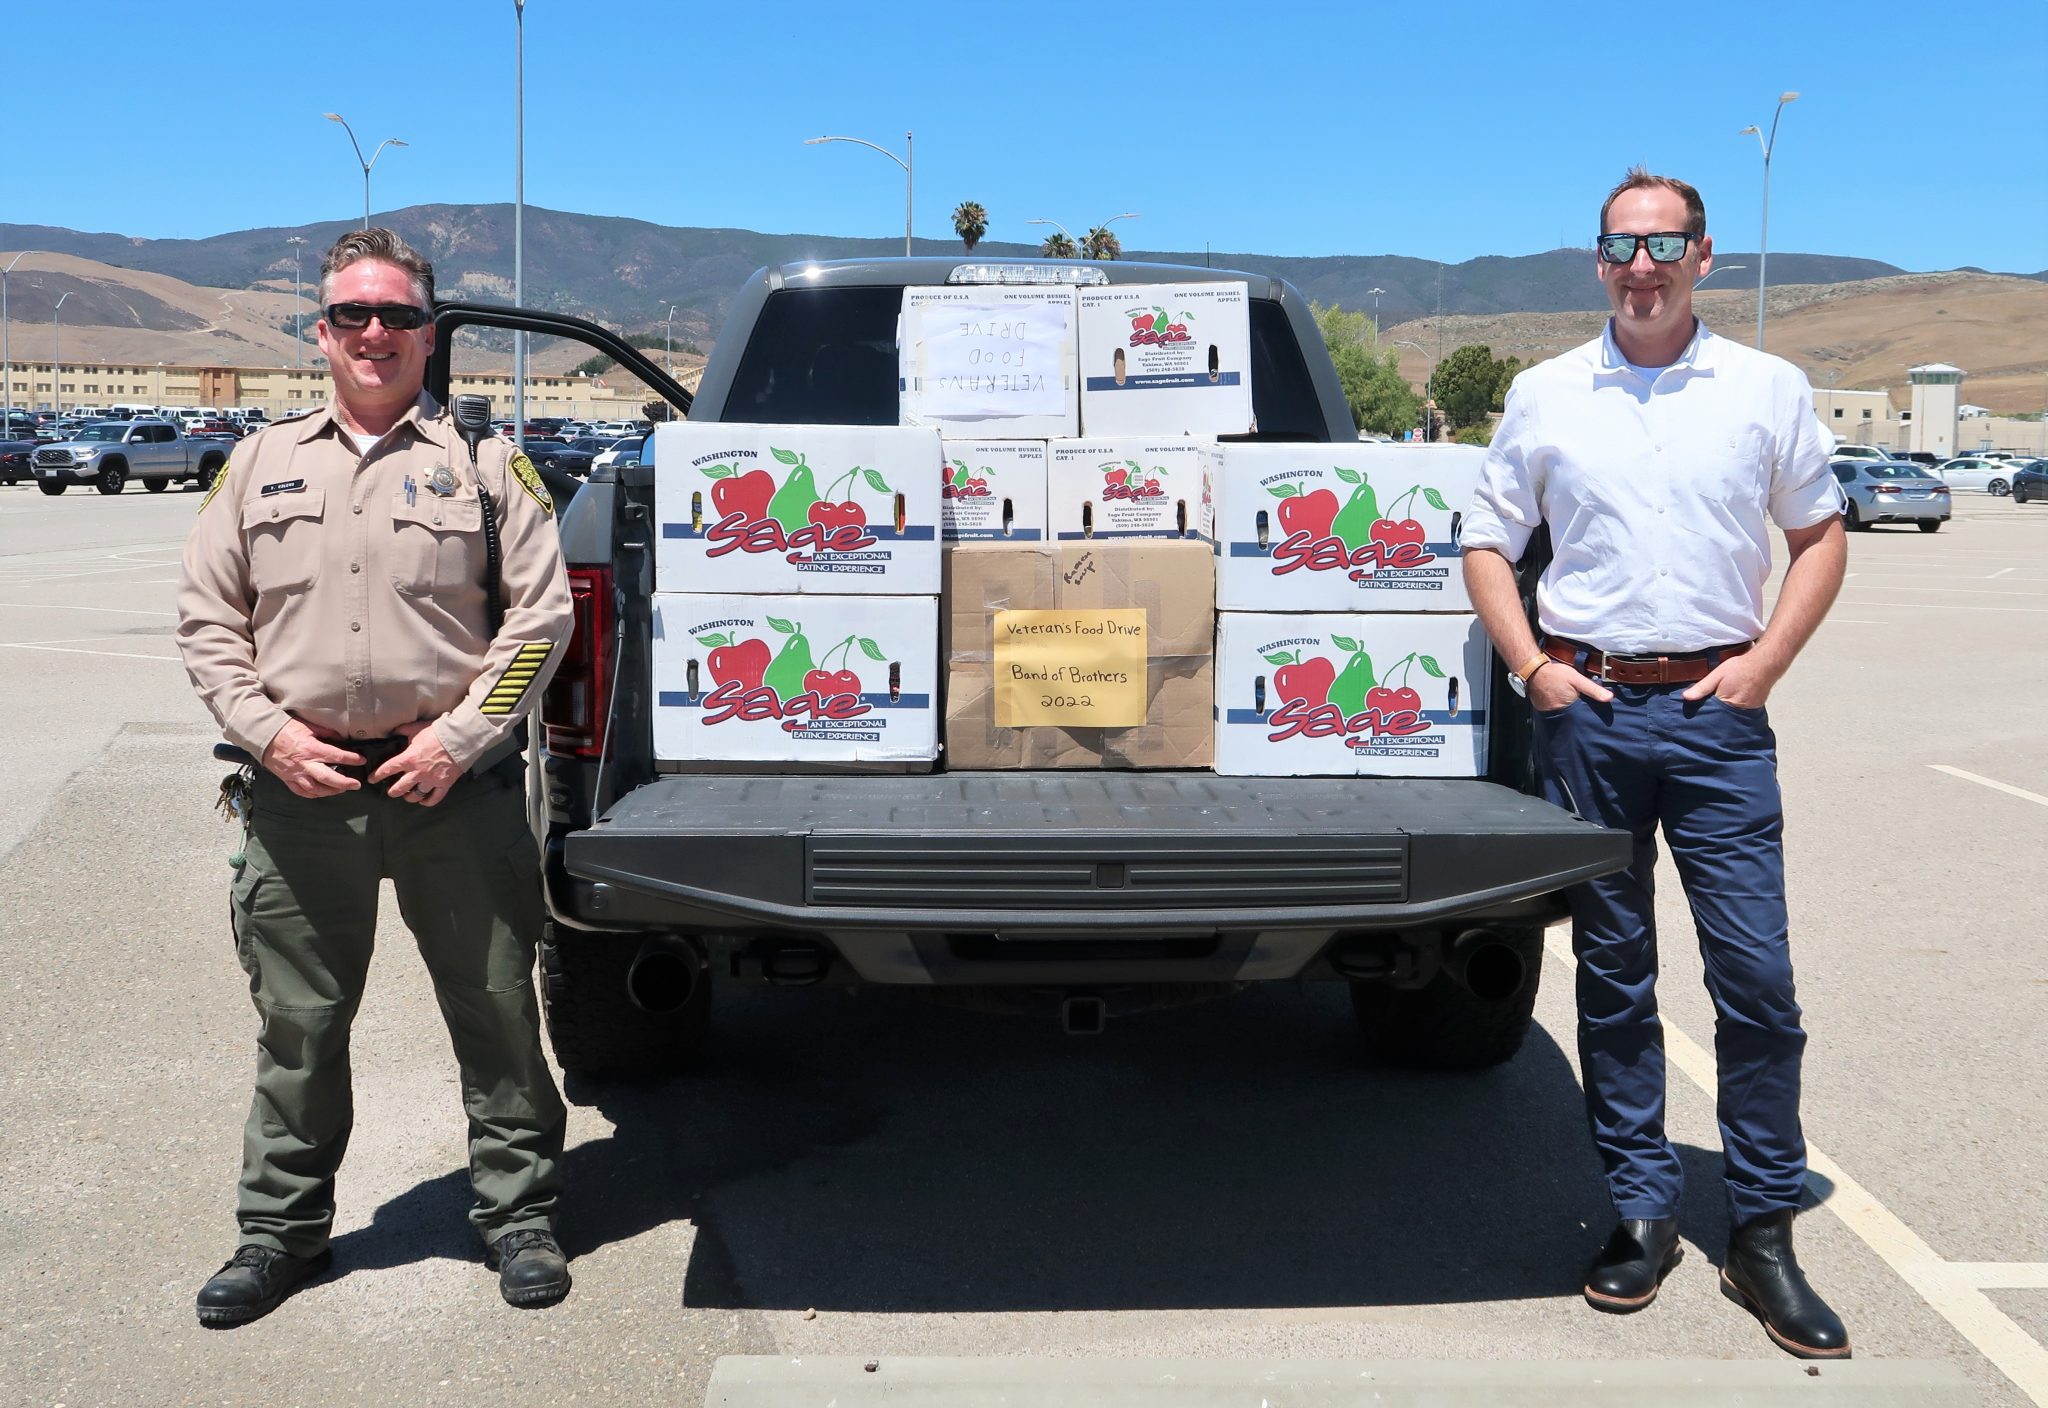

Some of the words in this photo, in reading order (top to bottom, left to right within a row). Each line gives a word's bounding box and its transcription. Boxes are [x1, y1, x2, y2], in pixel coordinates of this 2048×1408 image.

[960, 322, 1026, 341] DRIVE
[969, 348, 1024, 367] FOOD
[939, 375, 1045, 393] VETERANS
[691, 450, 759, 467] WASHINGTON
[1259, 470, 1324, 487] WASHINGTON
[942, 484, 992, 503] age
[830, 552, 890, 560] EXCEPTIONAL
[798, 563, 830, 571] EATING
[832, 564, 884, 573] EXPERIENCE
[1390, 569, 1448, 577] EXCEPTIONAL
[1360, 580, 1390, 588] EATING
[1392, 581, 1441, 589] EXPERIENCE
[688, 619, 754, 636] WASHINGTON
[1006, 621, 1072, 635] Veteran's
[1075, 621, 1104, 635] Food
[1108, 620, 1141, 636] Drive
[1257, 638, 1321, 654] WASHINGTON
[1012, 665, 1048, 681] Band
[1052, 667, 1066, 681] of
[1070, 667, 1128, 684] Brothers
[1041, 695, 1095, 708] 2022
[825, 720, 885, 728] EXCEPTIONAL
[827, 732, 878, 740] EXPERIENCE
[1386, 736, 1444, 744] EXCEPTIONAL
[1388, 749, 1437, 757] EXPERIENCE
